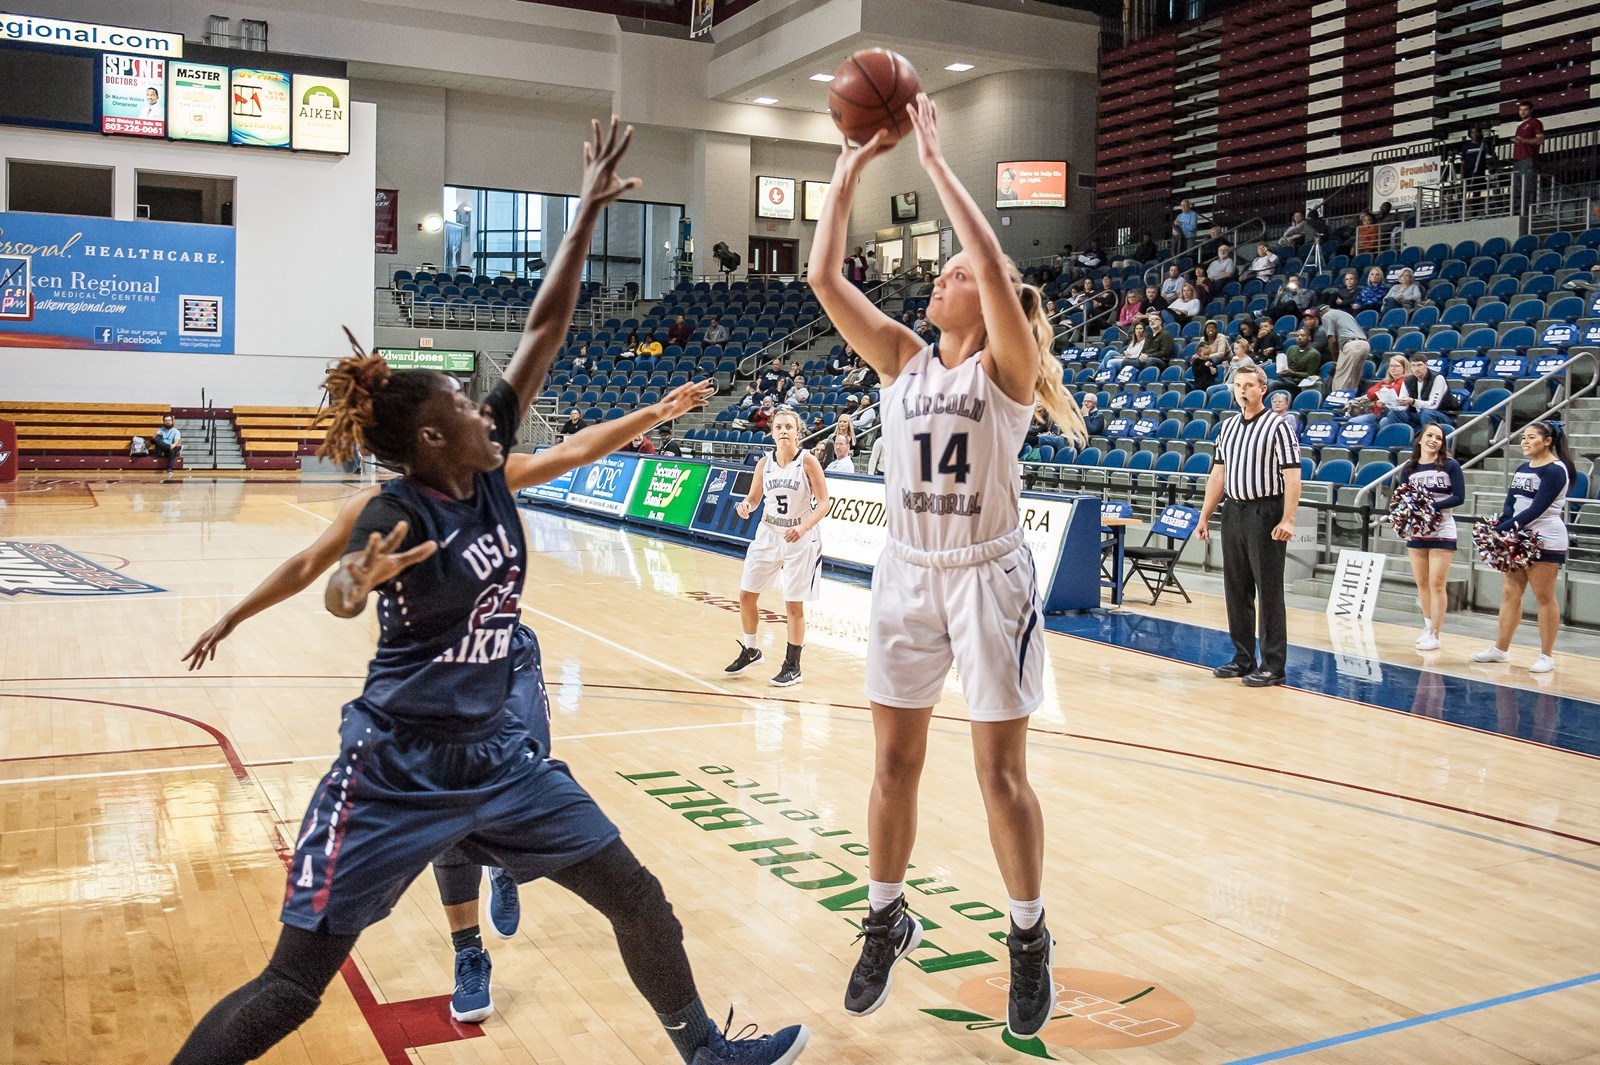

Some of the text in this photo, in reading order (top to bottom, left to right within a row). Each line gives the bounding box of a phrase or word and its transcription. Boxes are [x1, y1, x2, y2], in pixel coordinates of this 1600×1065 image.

[0, 20, 169, 50] gional.com
[106, 56, 163, 78] SPINE
[177, 68, 220, 81] MASTER
[106, 76, 138, 86] DOCTORS
[299, 107, 343, 120] AIKEN
[105, 123, 163, 135] 803-226-0061
[84, 245, 225, 264] HEALTHCARE.
[70, 271, 161, 296] Regional
[53, 290, 156, 302] MEDICAL CENTERS
[117, 335, 162, 345] Facebook
[913, 432, 971, 484] 14
[597, 466, 623, 491] CPC
[654, 462, 683, 481] Security
[648, 476, 678, 493] Federal
[765, 479, 801, 491] LINCOLN
[643, 490, 664, 507] Bank
[776, 495, 788, 515] 5
[902, 488, 981, 517] MEMORIAL
[1334, 558, 1364, 616] WHITE
[614, 769, 764, 832] BELT
